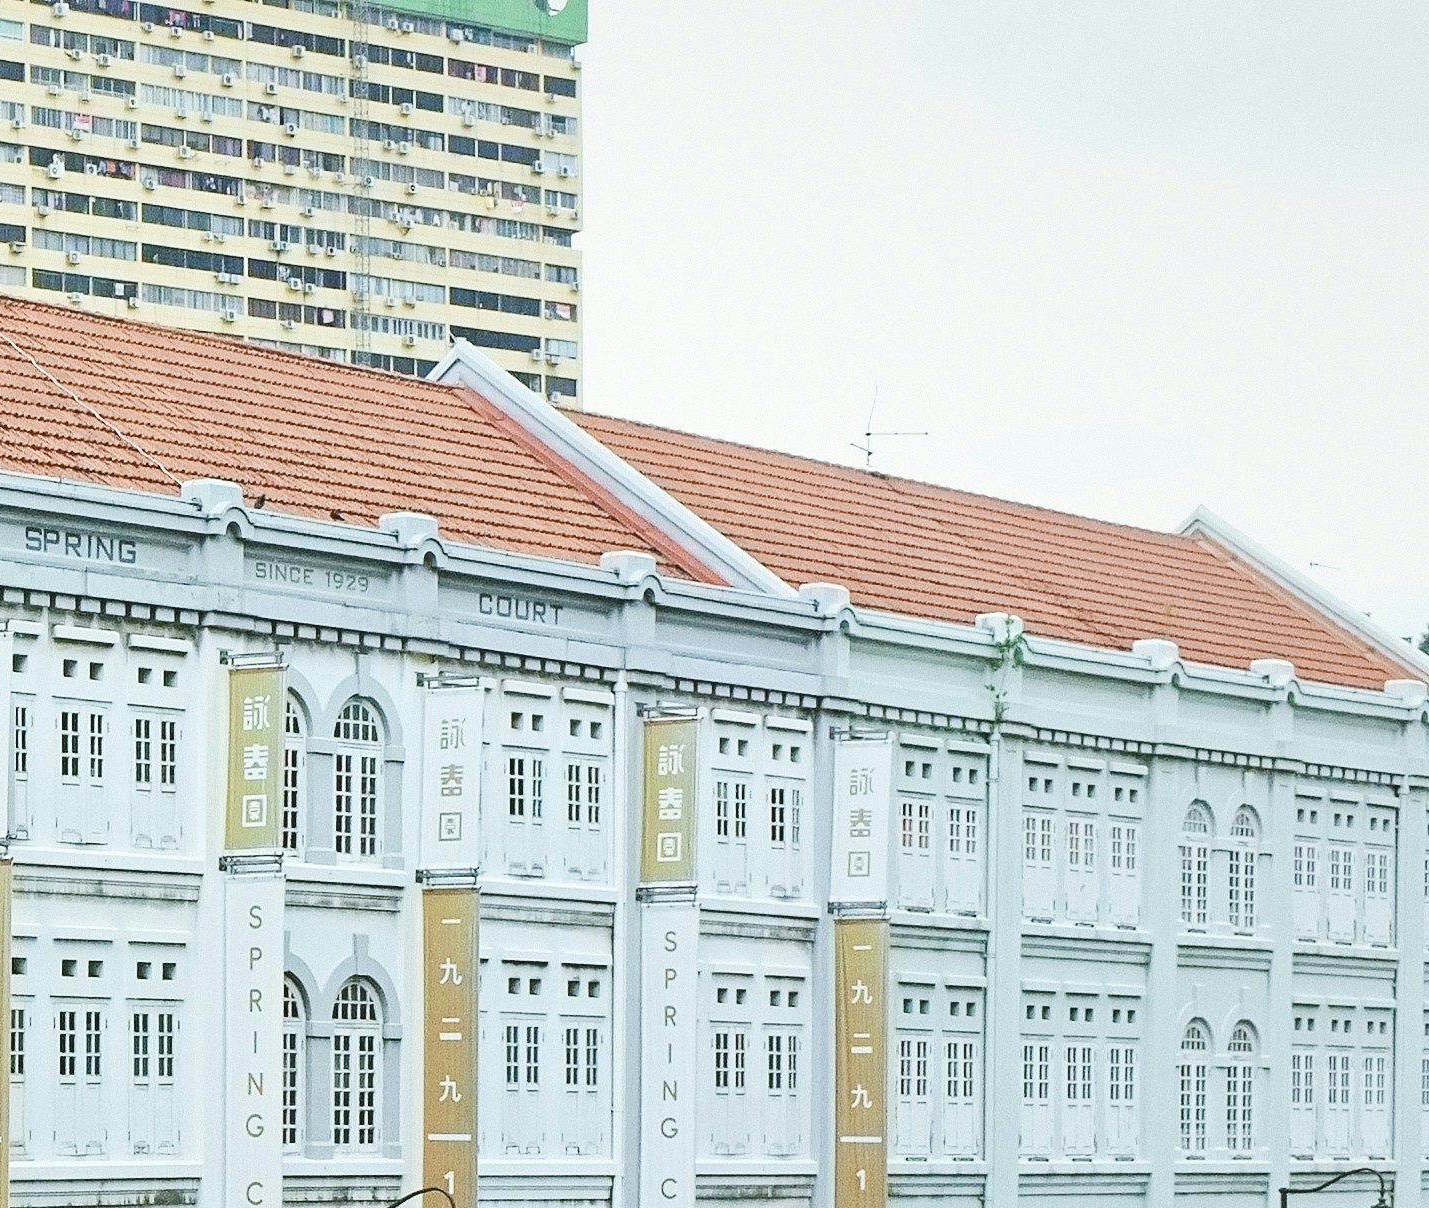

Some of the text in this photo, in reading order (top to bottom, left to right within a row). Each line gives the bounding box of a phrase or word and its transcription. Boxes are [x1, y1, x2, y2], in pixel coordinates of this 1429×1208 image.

[24, 525, 137, 565] SPRING
[254, 561, 370, 593] SINCE 1929
[479, 592, 564, 626] COURT
[245, 904, 265, 1139] SPRING
[438, 918, 462, 1104] 一九二九
[660, 930, 679, 1140] SPRING
[850, 944, 873, 1110] 一九二九
